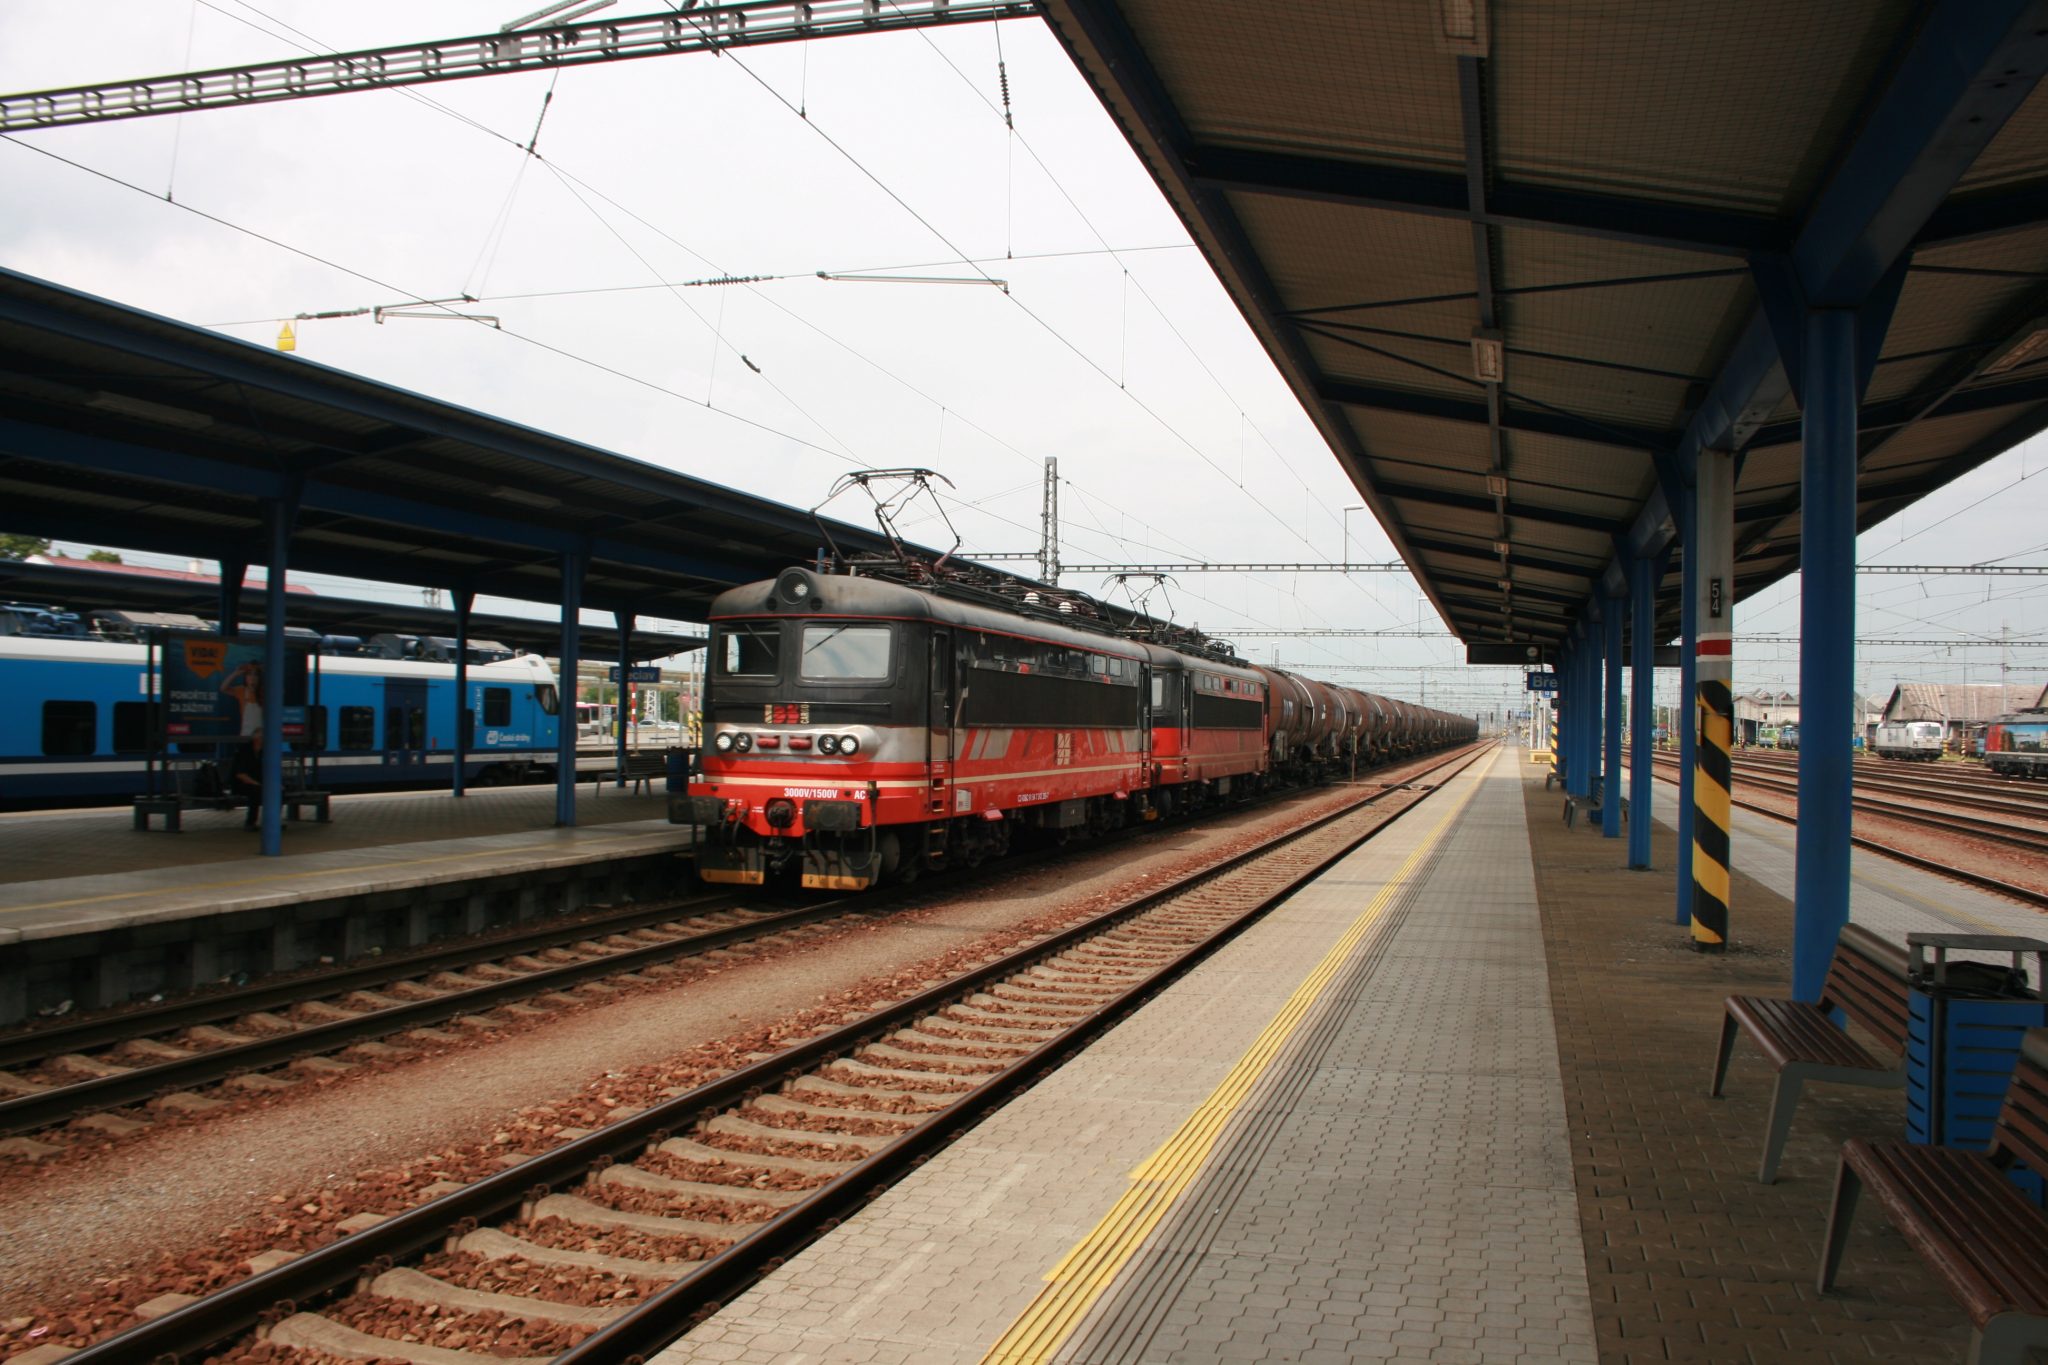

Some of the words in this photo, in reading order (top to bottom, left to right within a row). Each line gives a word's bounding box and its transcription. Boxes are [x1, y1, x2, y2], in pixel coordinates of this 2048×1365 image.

[613, 669, 656, 680] Beclav
[1533, 675, 1558, 688] Bře
[784, 787, 838, 799] 3000V/1500V
[854, 790, 866, 800] AC
